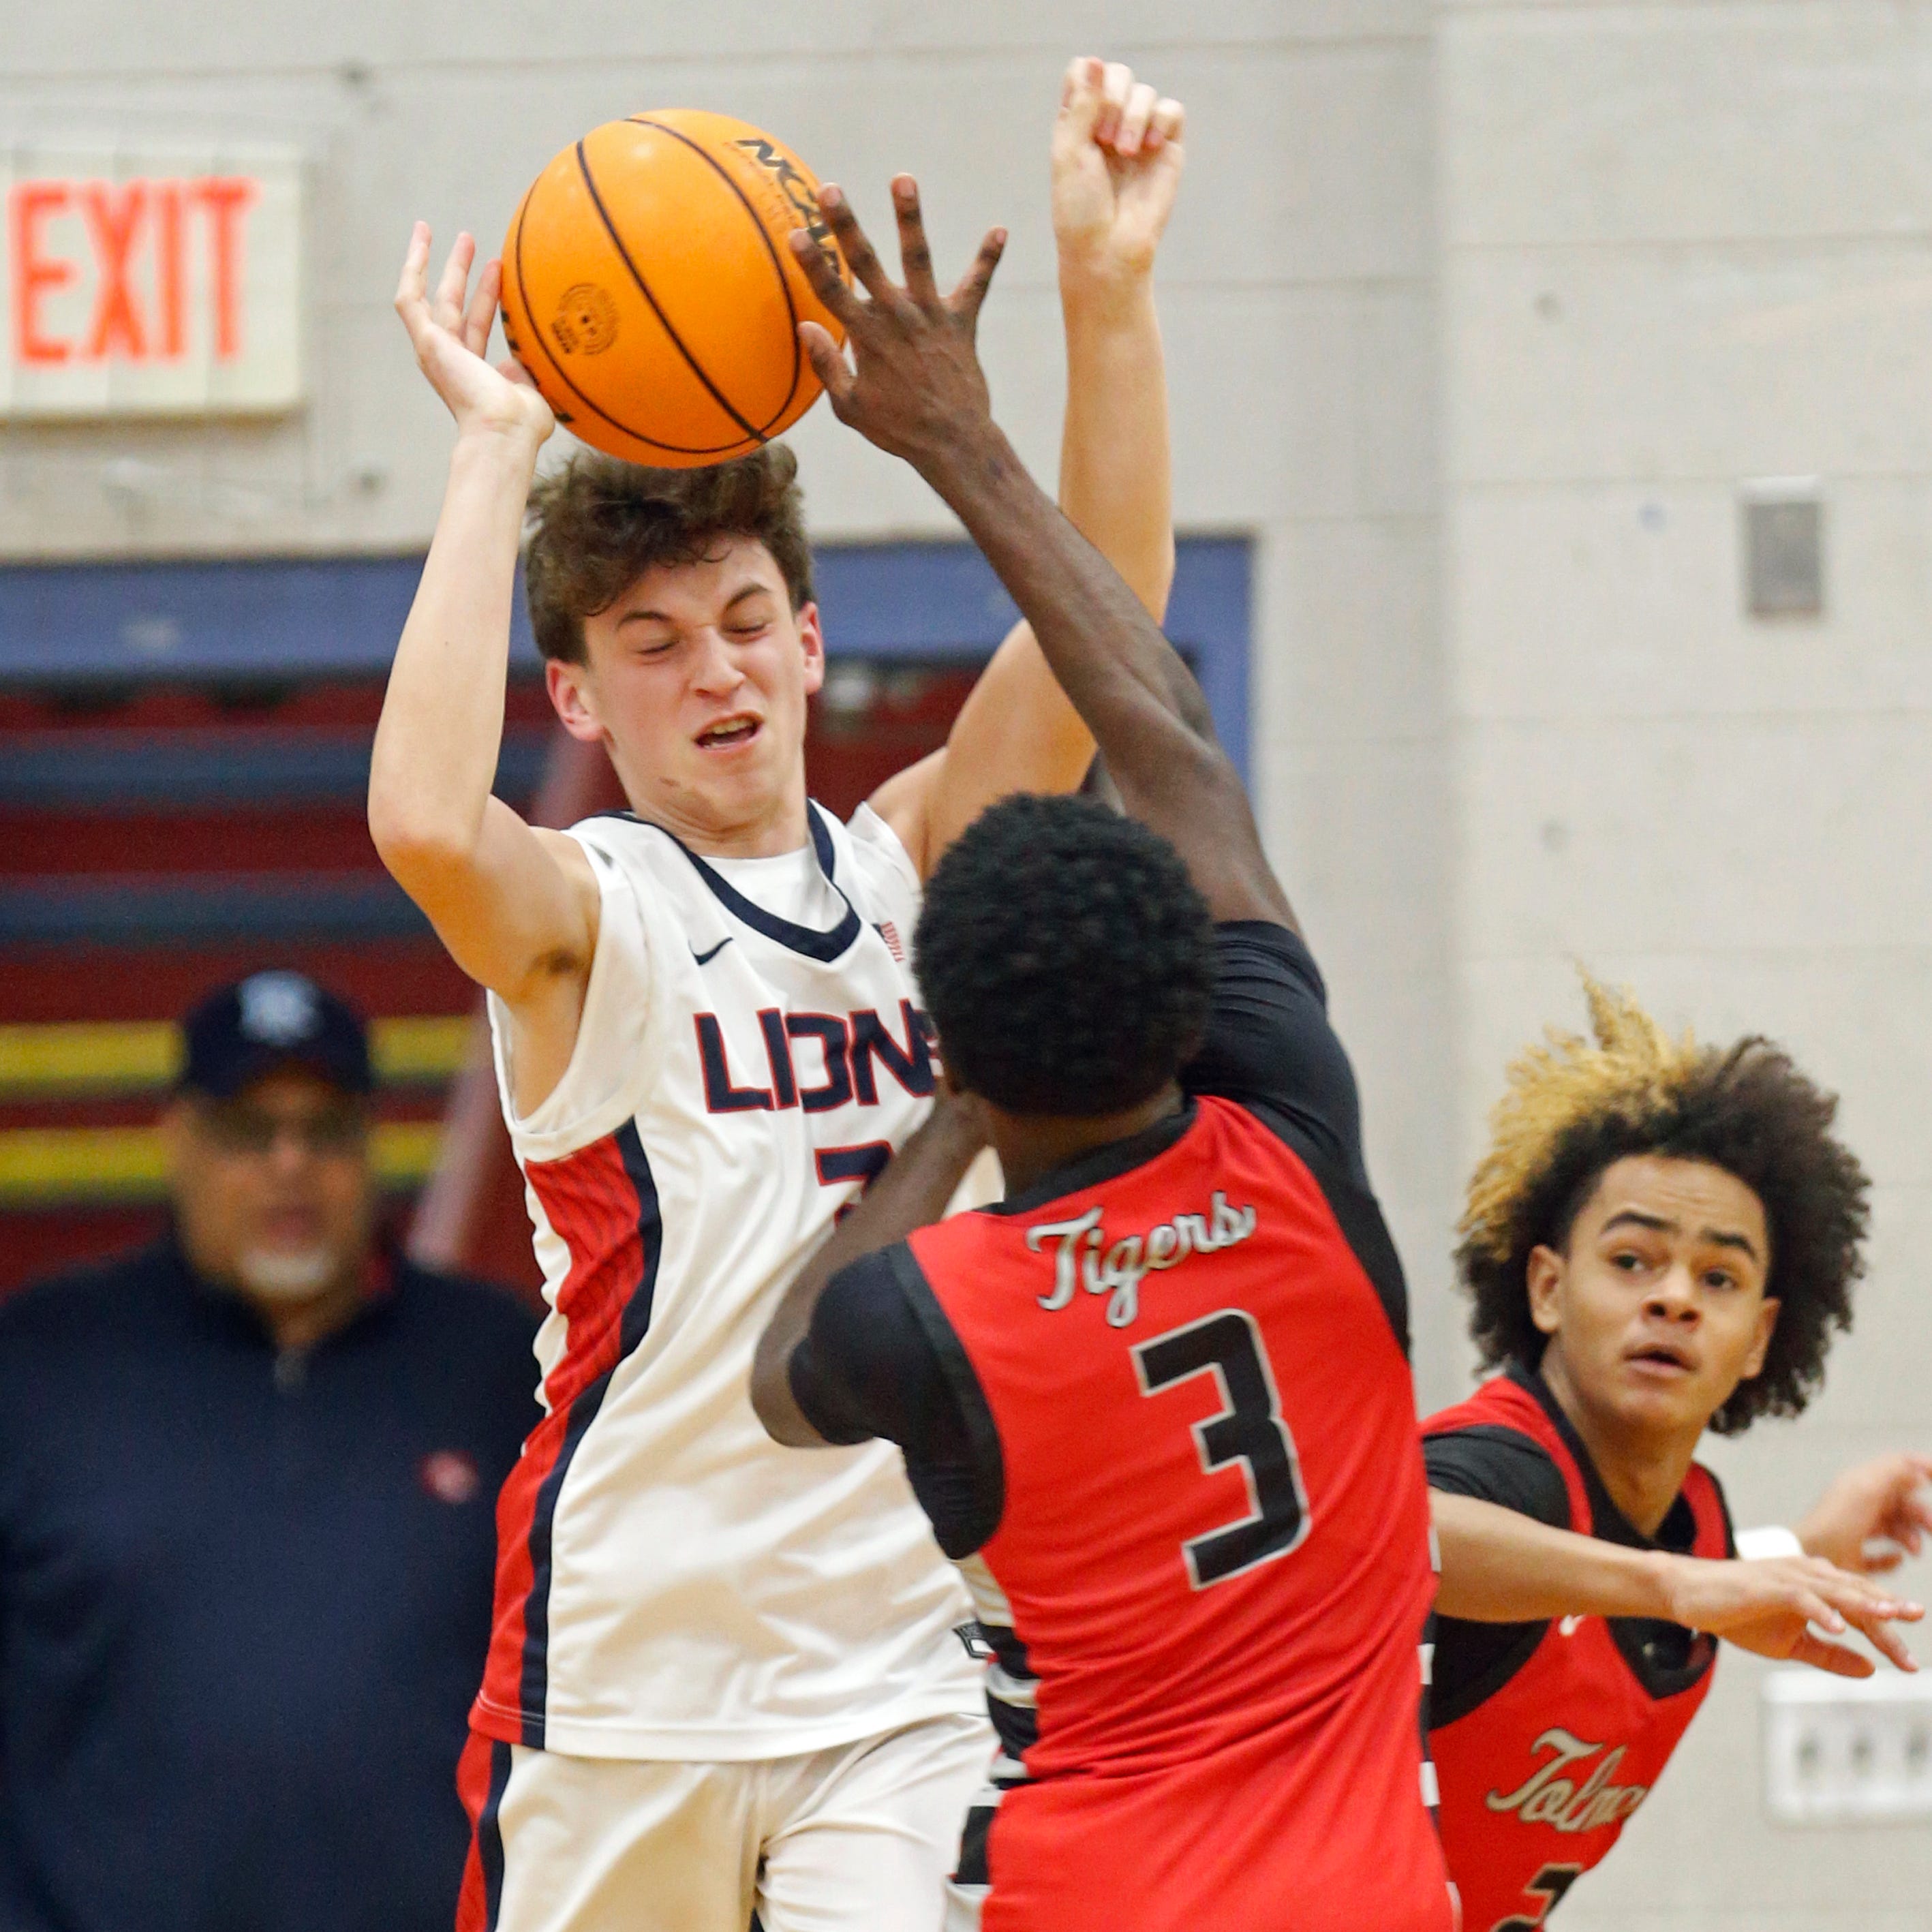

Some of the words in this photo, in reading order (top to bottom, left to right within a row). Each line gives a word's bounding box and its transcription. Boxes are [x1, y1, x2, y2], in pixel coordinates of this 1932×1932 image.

[10, 177, 259, 365] EXIT
[1026, 1191, 1257, 1328] Tigers
[1129, 1308, 1312, 1591] 3
